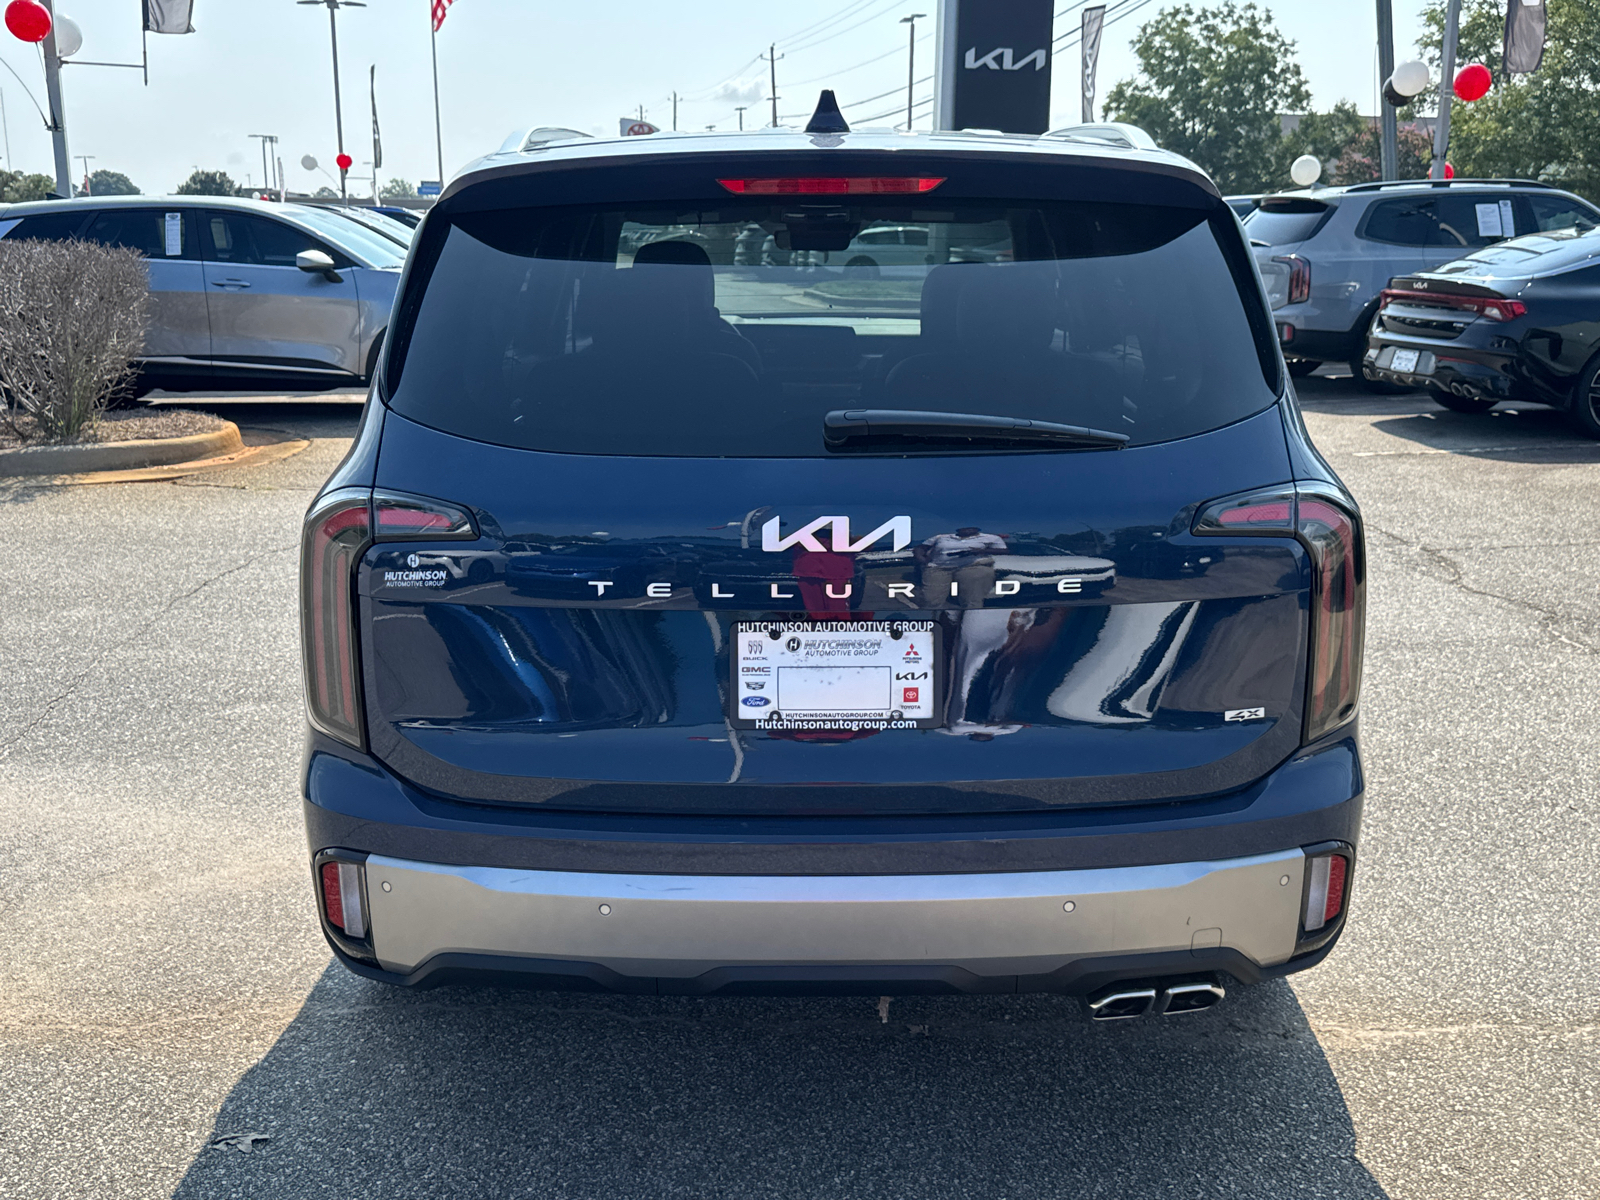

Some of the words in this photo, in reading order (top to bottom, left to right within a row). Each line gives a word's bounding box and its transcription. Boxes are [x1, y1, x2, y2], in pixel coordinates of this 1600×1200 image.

[965, 47, 1046, 71] KIA
[762, 515, 911, 553] KIA
[385, 571, 447, 580] HUTCHINSON
[588, 578, 1083, 598] TELLURIDE
[737, 621, 811, 632] HUTCHINSON
[814, 621, 890, 632] AUTOMOTIVE
[893, 621, 934, 632] GROUP
[803, 639, 883, 650] HUTCHINSON
[896, 672, 928, 680] KIA
[755, 719, 917, 730] Hutchinsonautogroup.com
